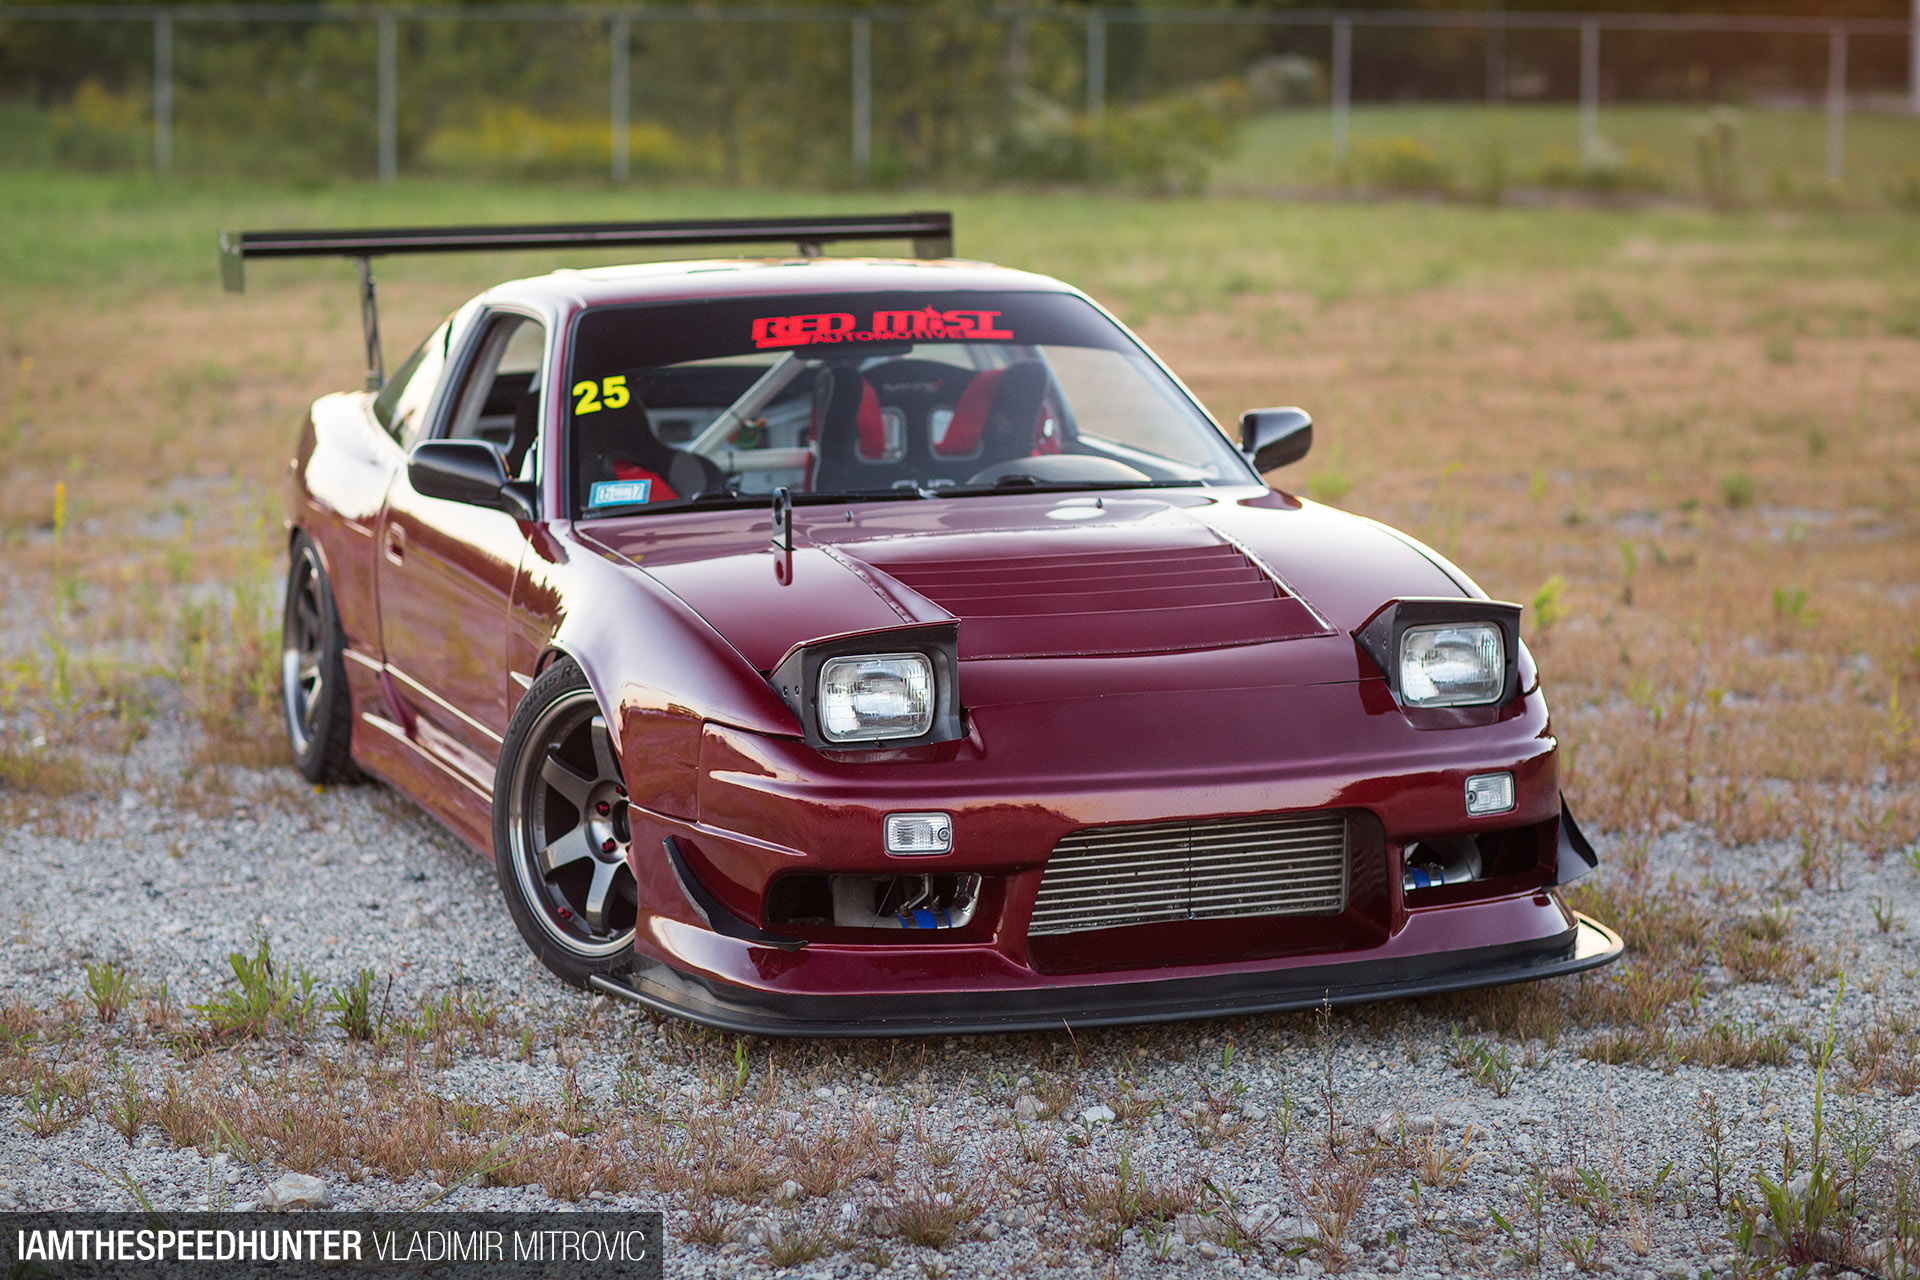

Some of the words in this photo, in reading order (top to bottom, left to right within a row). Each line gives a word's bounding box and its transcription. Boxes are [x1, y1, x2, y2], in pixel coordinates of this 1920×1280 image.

[752, 313, 856, 345] RED
[811, 329, 965, 344] AUTOMOTIVE
[572, 375, 631, 416] 25
